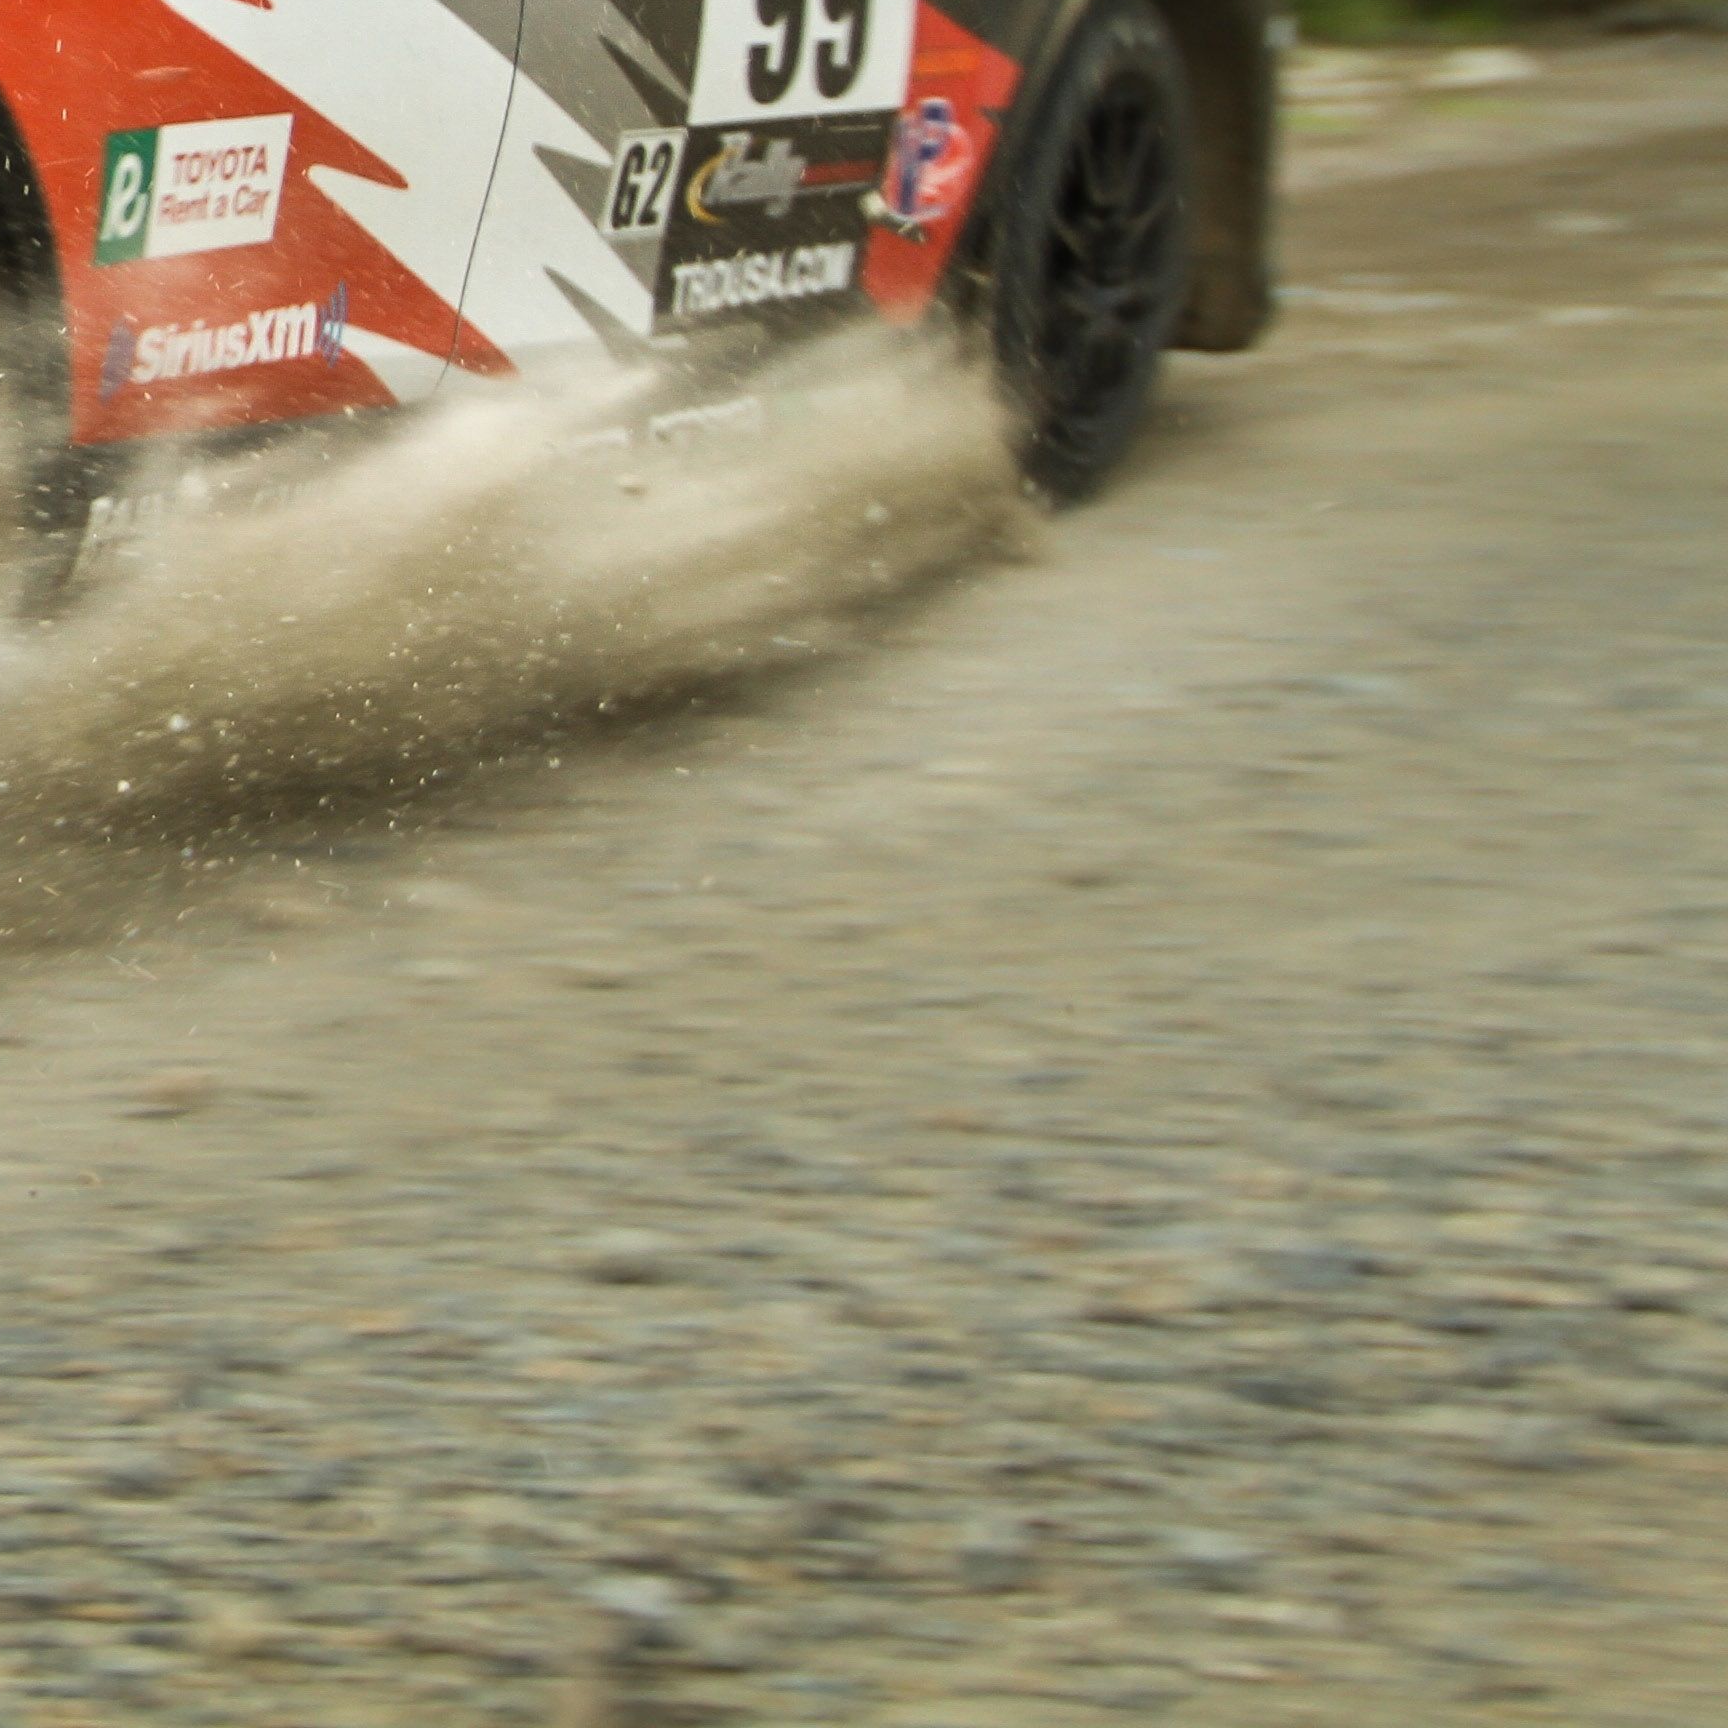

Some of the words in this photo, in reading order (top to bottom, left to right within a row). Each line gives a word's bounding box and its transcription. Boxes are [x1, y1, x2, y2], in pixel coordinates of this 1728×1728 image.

[172, 144, 269, 186] TOYOTA
[610, 140, 674, 229] G2
[160, 193, 211, 223] Rent
[214, 196, 228, 219] a
[231, 185, 272, 219] Car
